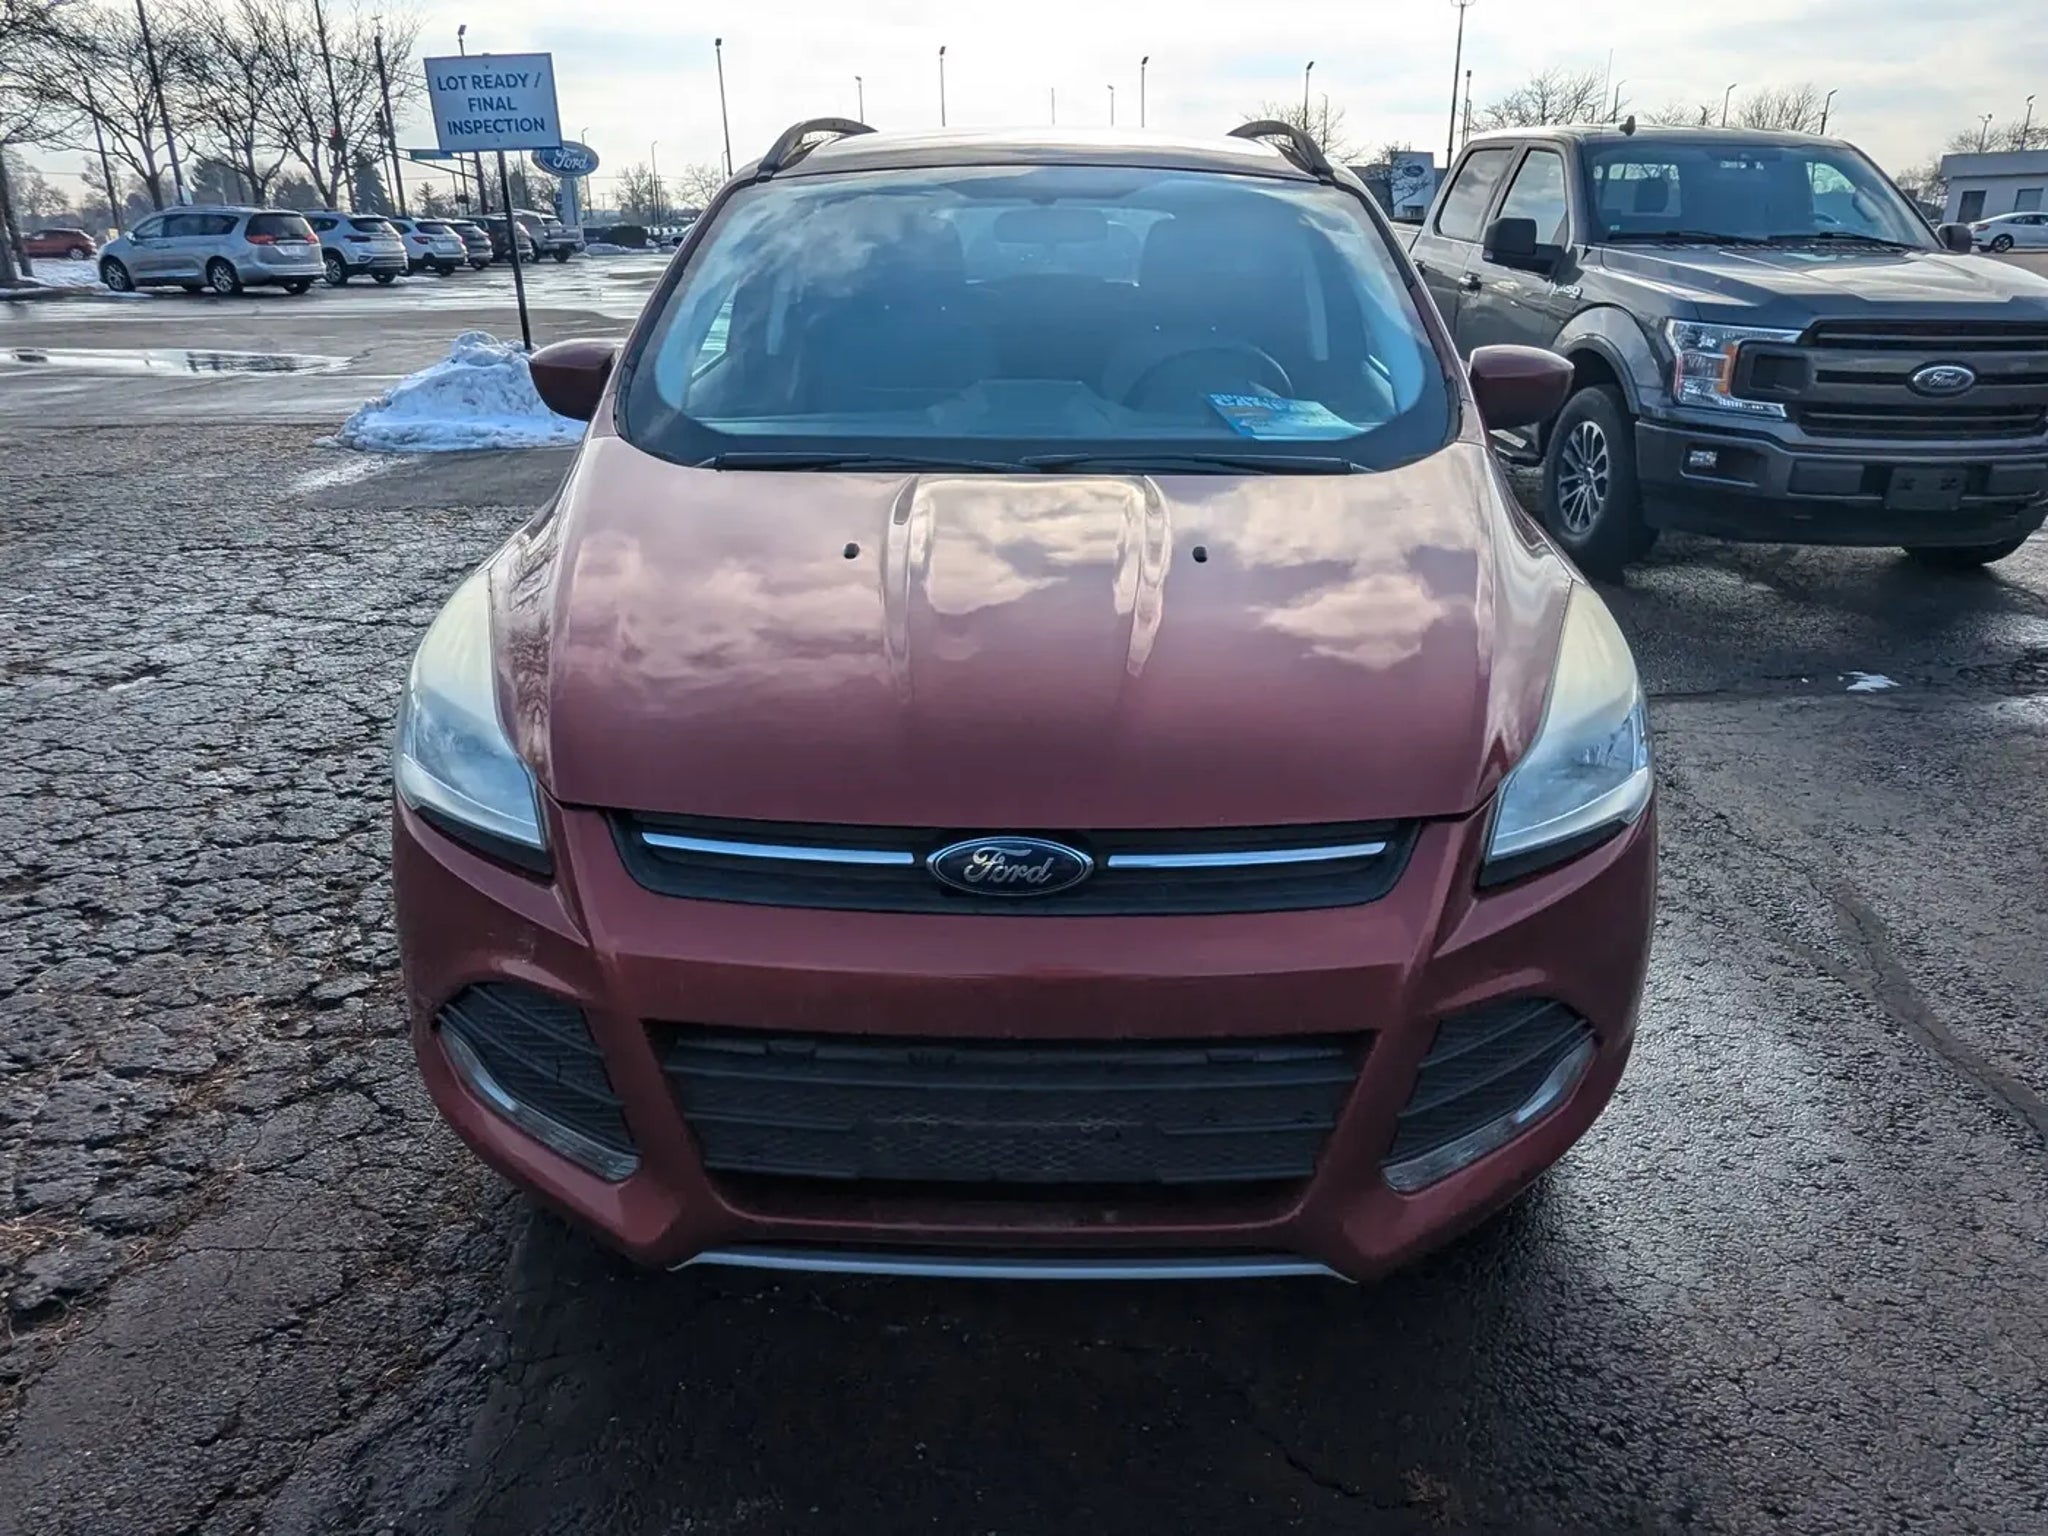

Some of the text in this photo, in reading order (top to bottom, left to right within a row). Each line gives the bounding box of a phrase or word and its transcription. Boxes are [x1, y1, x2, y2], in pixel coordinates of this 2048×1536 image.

[437, 75, 467, 91] LOT
[472, 73, 529, 90] READY
[468, 96, 518, 113] FINAL
[447, 117, 546, 135] INSPECTION
[553, 146, 588, 170] Ford
[1929, 371, 1962, 386] Ford
[963, 846, 1054, 884] Ford
